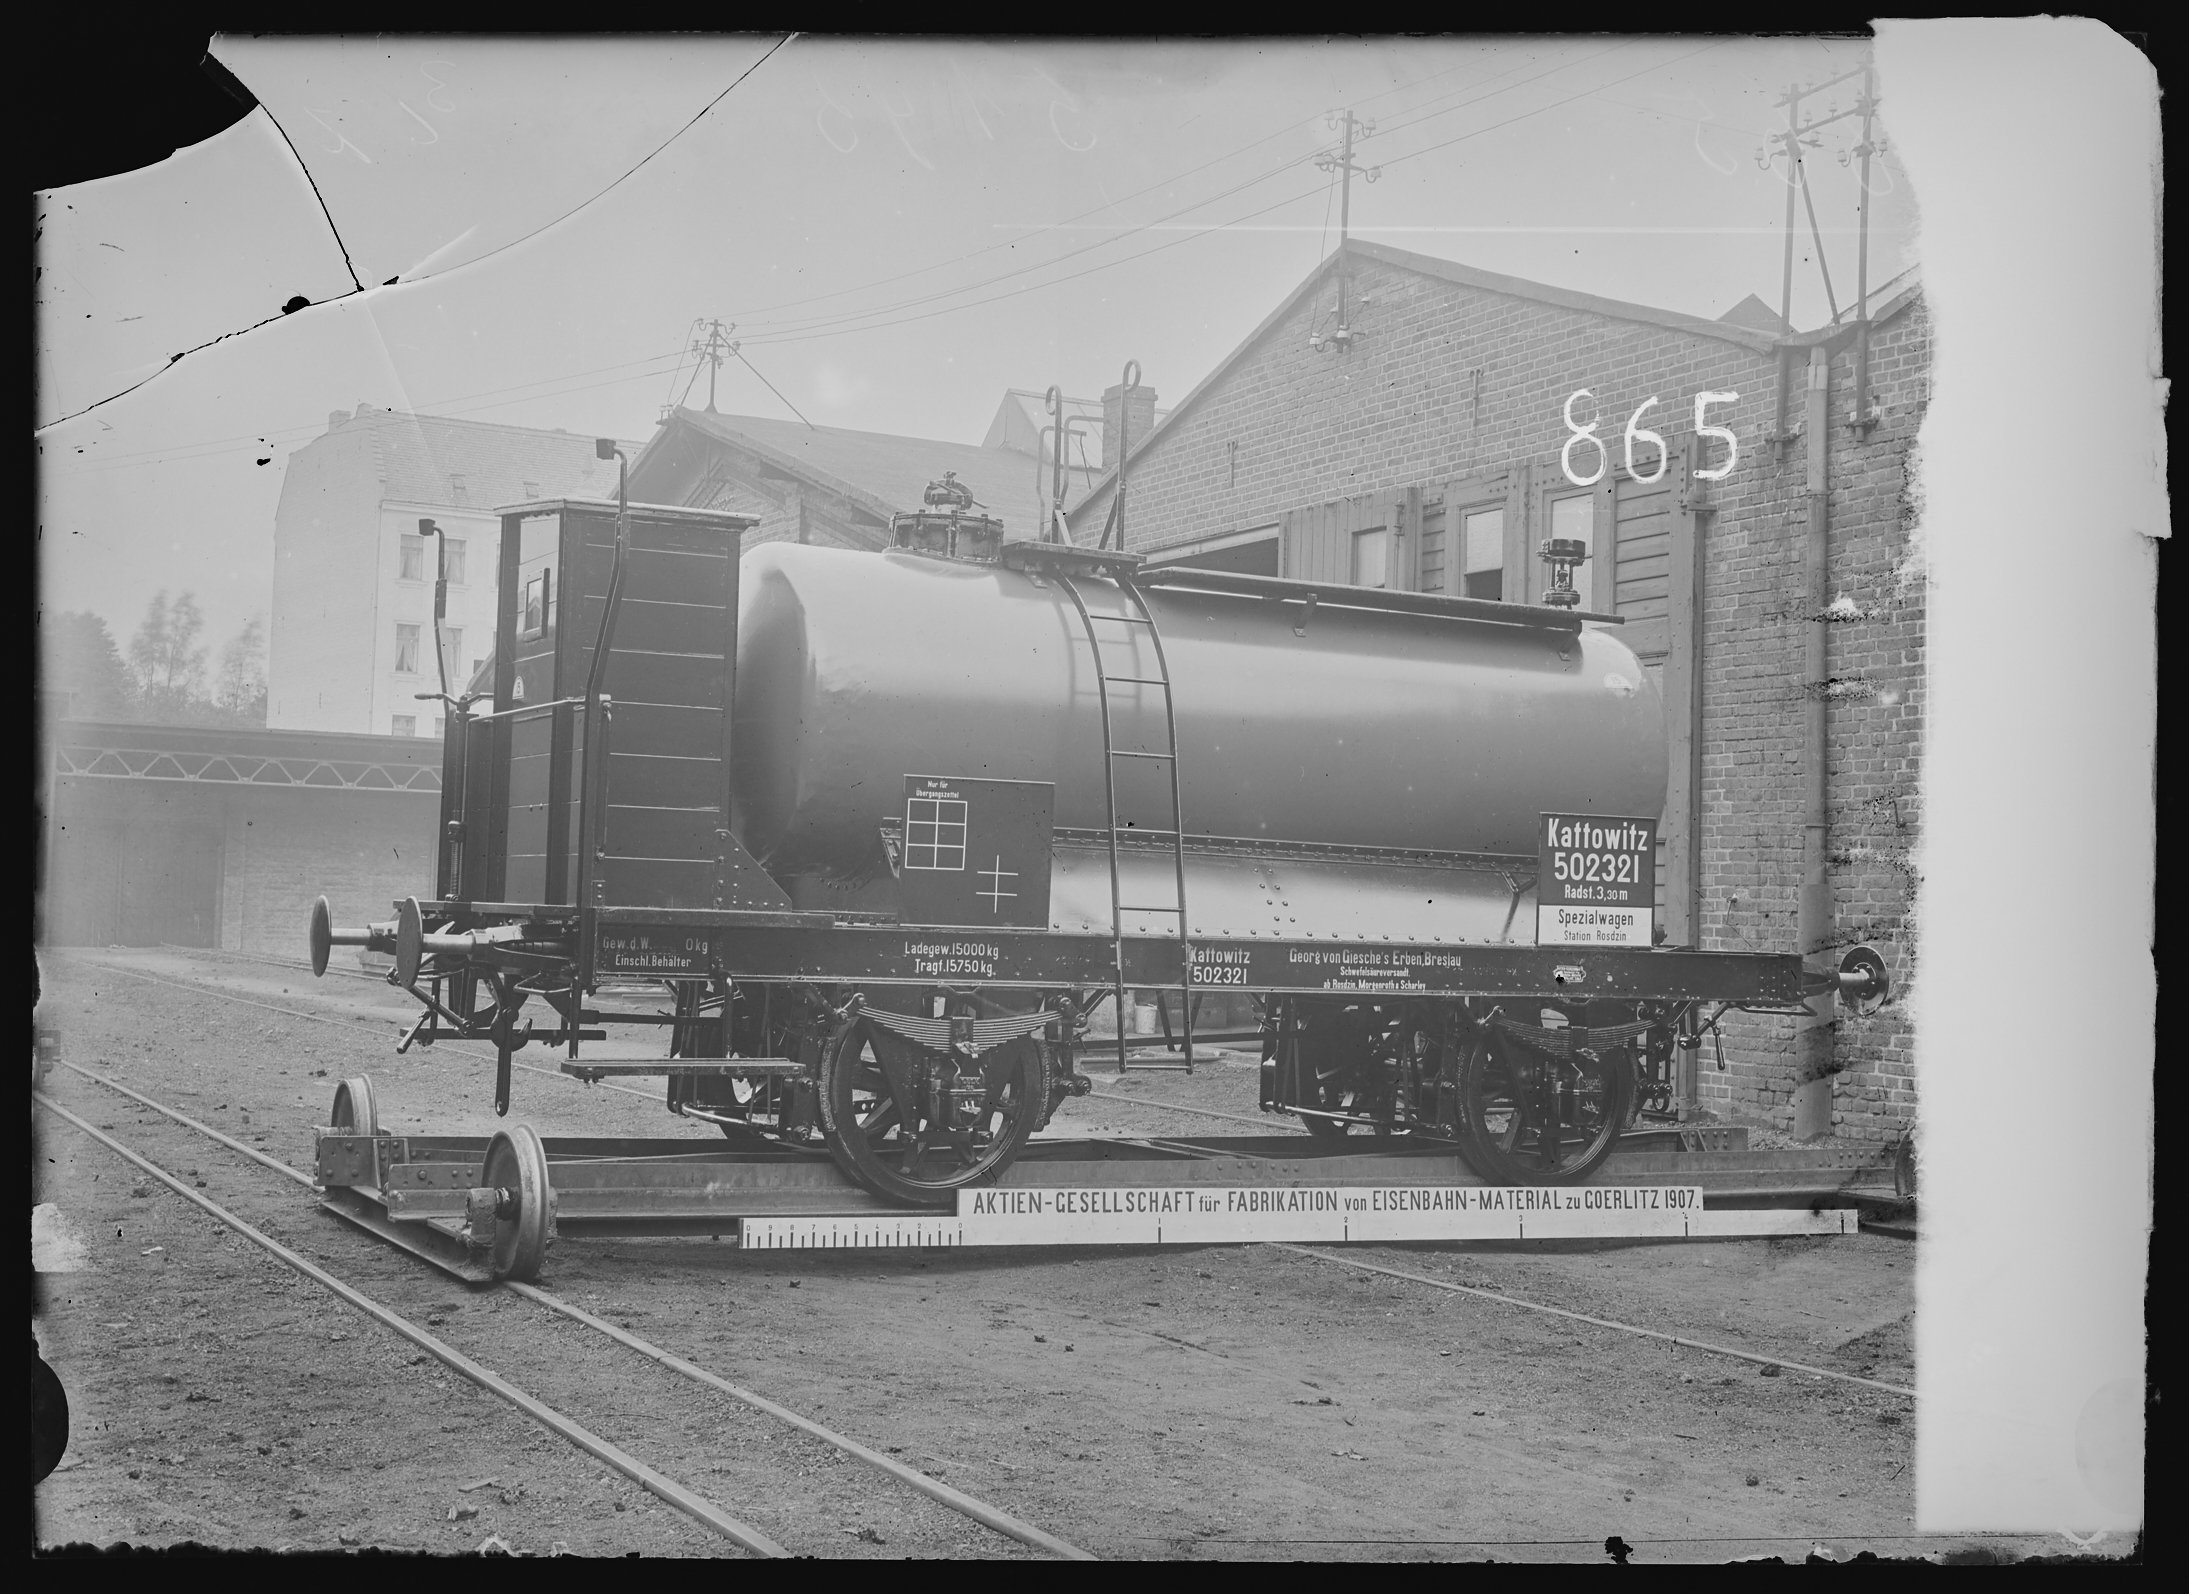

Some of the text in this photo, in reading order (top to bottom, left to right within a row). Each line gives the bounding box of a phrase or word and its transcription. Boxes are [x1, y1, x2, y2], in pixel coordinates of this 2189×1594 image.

[1561, 388, 1740, 486] 865
[915, 787, 960, 799] Übergangszettel
[927, 780, 949, 789] Nur für
[1547, 818, 1648, 851] Kattowitz
[1554, 851, 1639, 883] 502321
[1558, 908, 1634, 929] Spezialwagen
[1564, 930, 1627, 941] Station Rosdzin
[1190, 946, 1251, 964] Kattowitz
[1289, 947, 1321, 965] Georg
[1323, 952, 1341, 964] von
[1342, 949, 1389, 966] Giesche's
[1193, 966, 1247, 984] 502321
[1323, 979, 1331, 990] ab
[1358, 979, 1395, 993] Morgenroth
[1400, 979, 1426, 995] Scharley
[973, 1189, 1700, 1214] AKTIEN-GESELLSCHAFT für FABRIKATION von EISENBAHN-MATERIAL zu GOERLITZ 1907.
